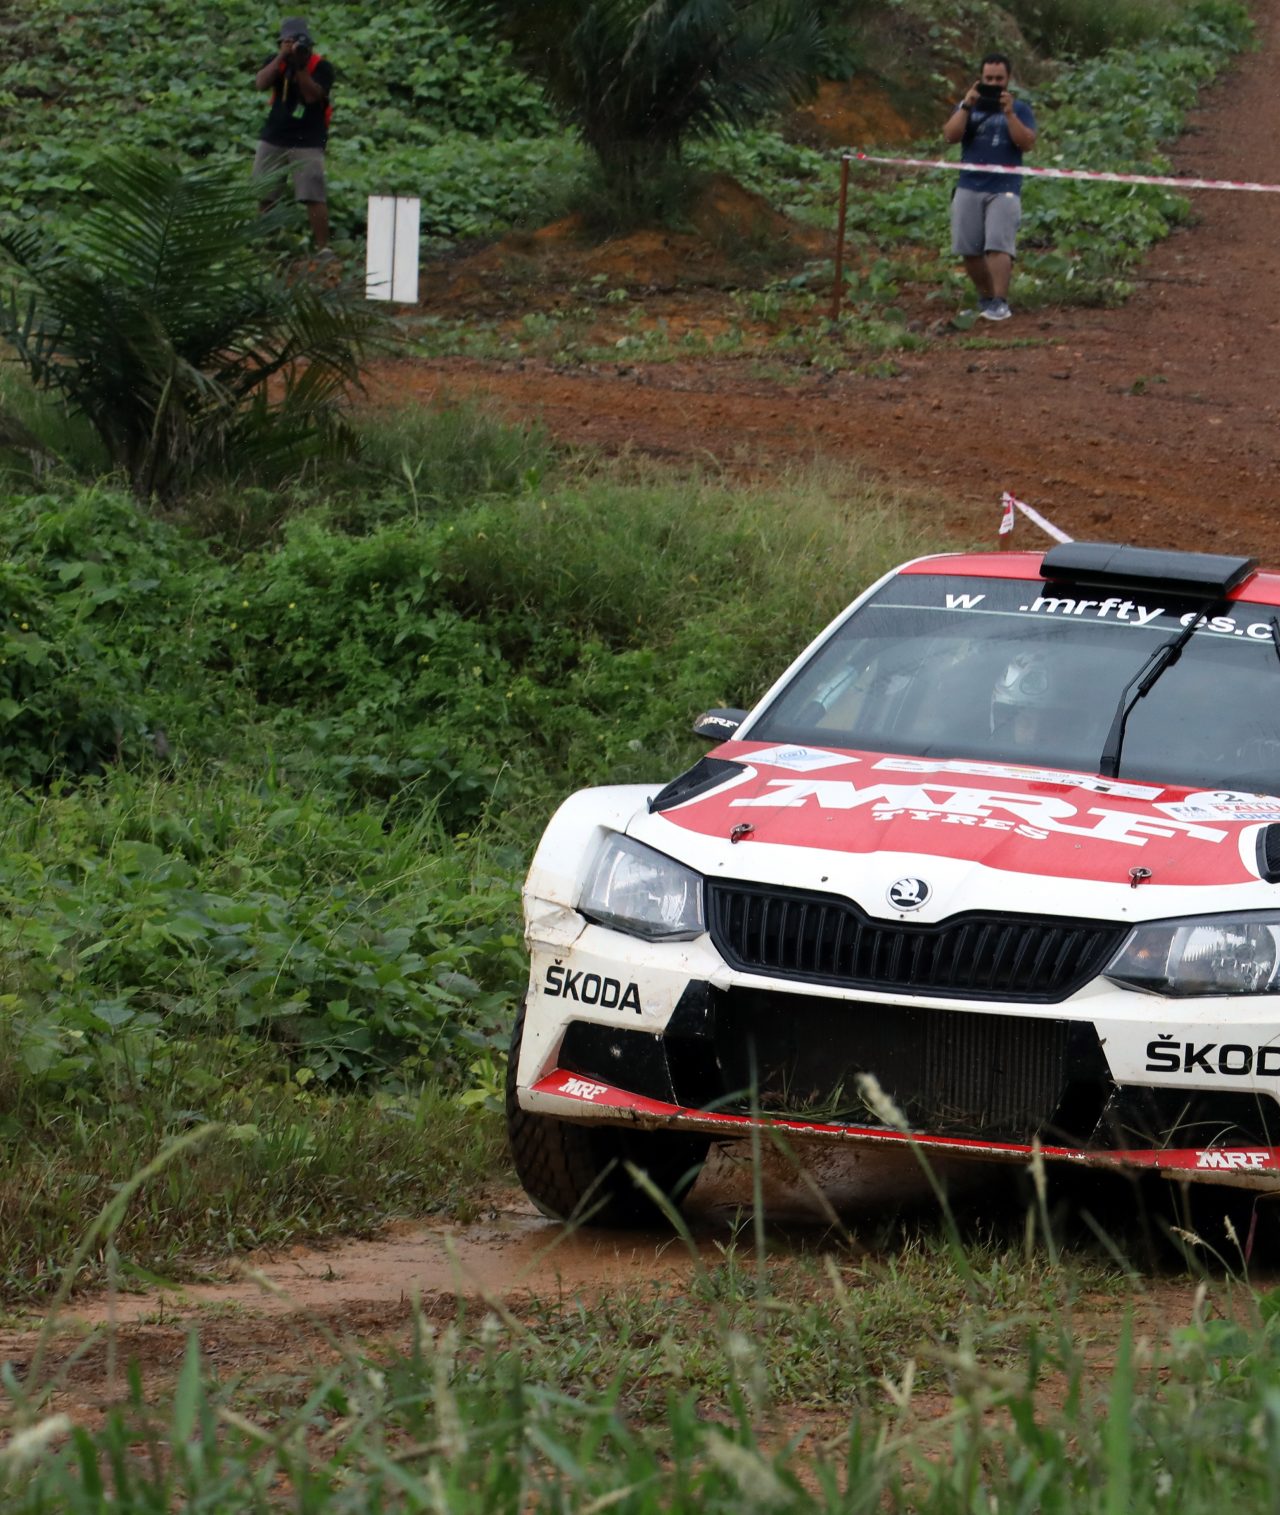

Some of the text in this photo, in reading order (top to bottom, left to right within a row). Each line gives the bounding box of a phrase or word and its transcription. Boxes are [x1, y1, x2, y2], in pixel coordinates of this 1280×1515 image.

[1213, 792, 1245, 803] 2
[728, 778, 1229, 846] MRF
[871, 809, 1050, 840] TYRES
[543, 958, 643, 1015] ŠKODA
[558, 1077, 608, 1100] MRF
[1195, 1151, 1270, 1169] MRF
